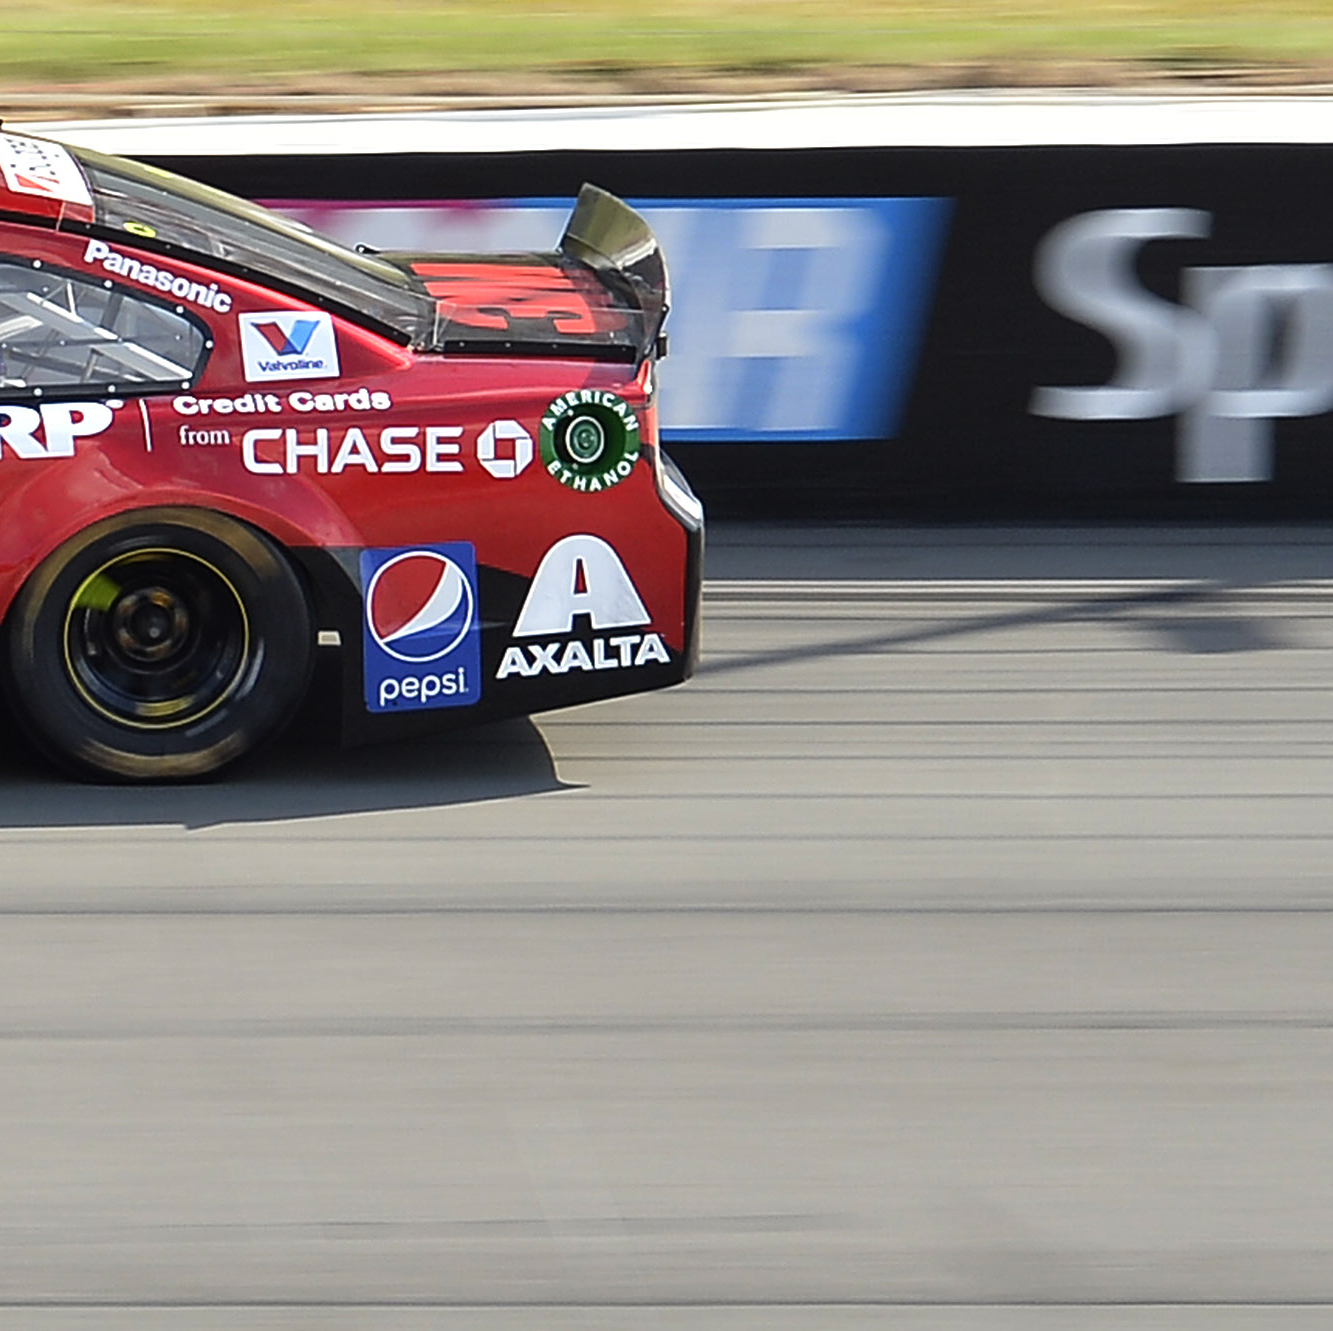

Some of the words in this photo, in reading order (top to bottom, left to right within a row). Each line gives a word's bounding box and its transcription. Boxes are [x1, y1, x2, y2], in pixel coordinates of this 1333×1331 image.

[83, 239, 232, 313] Panasonic
[257, 357, 324, 372] Valvoline
[172, 395, 283, 415] Credit
[288, 388, 391, 412] Cards
[541, 389, 639, 431] AMERICAN
[178, 424, 230, 446] from
[241, 426, 465, 475] CHASE
[547, 451, 639, 493] ETHANOL
[495, 631, 671, 681] AXALTA
[379, 666, 467, 707] pepsi
